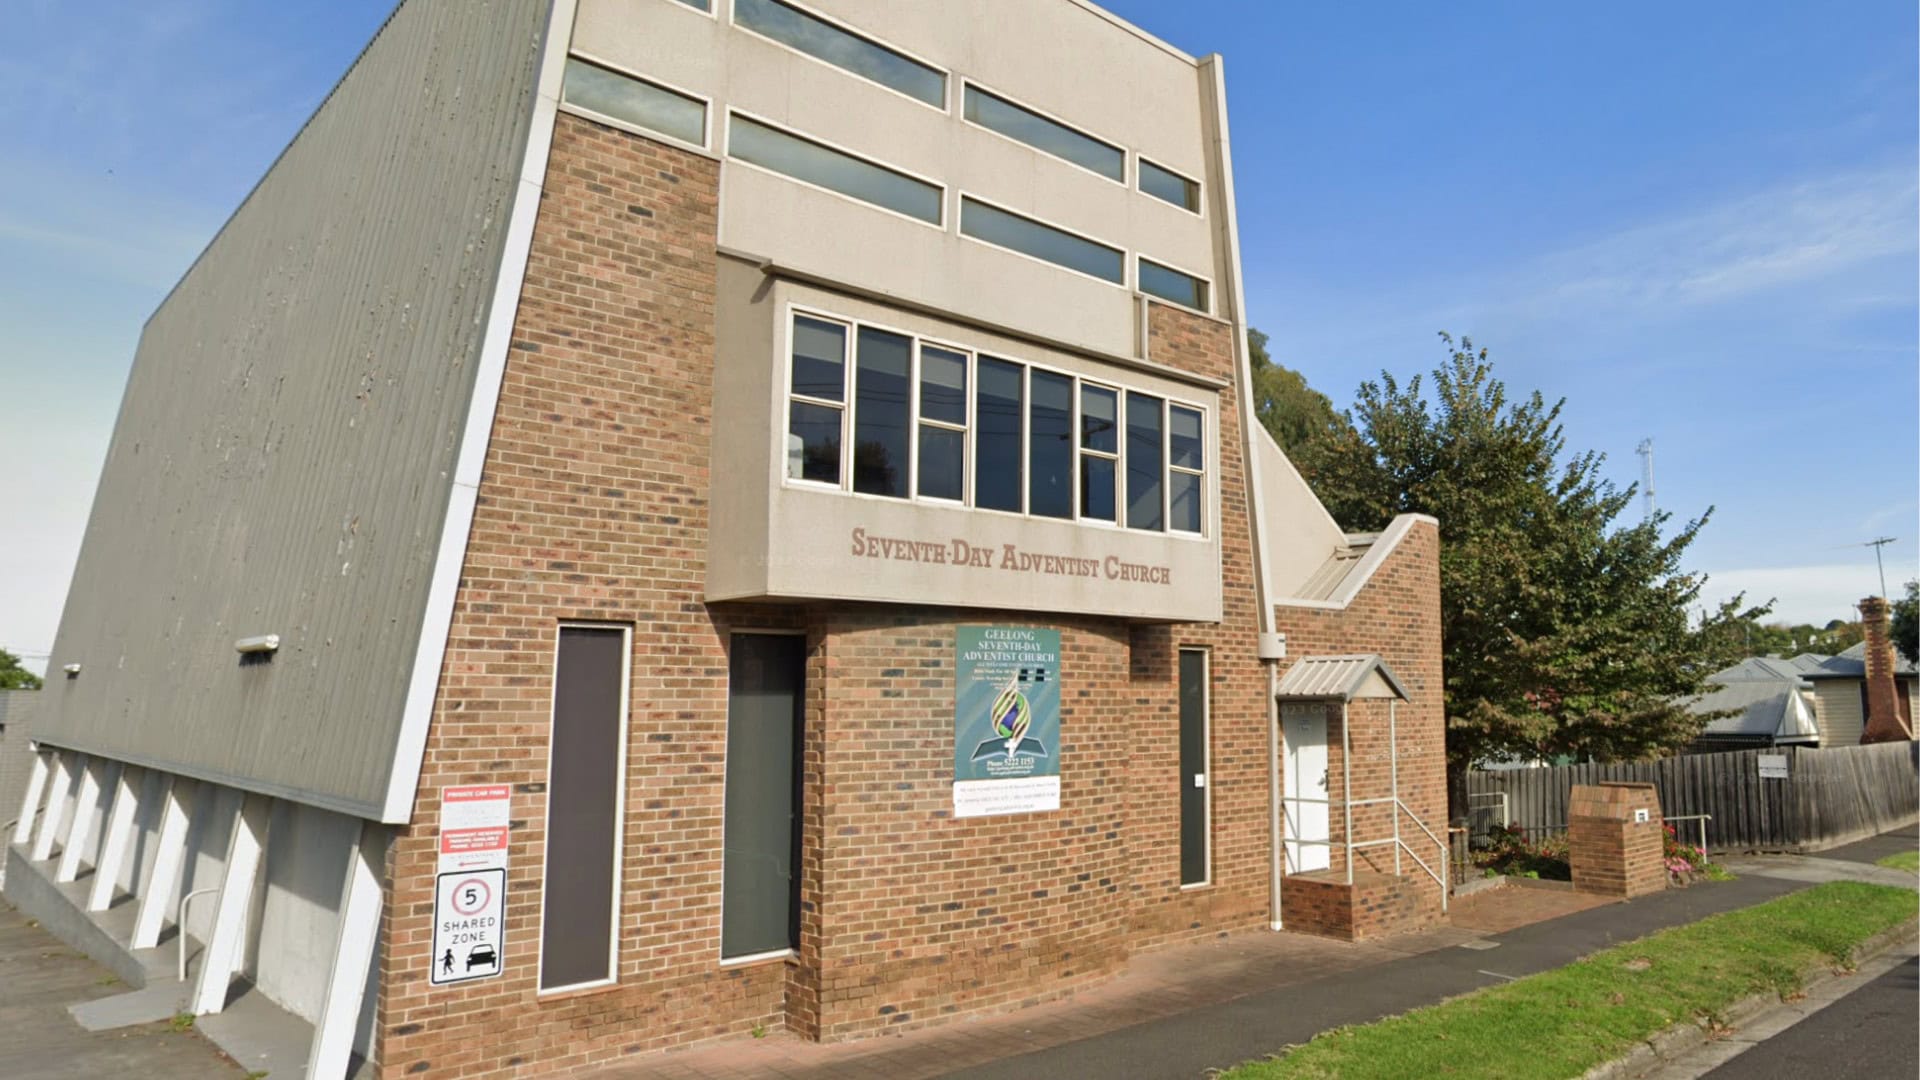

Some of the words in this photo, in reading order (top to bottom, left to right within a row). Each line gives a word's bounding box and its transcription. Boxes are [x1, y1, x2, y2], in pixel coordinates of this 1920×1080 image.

[1000, 543, 1099, 577] ADVENTIST
[1104, 555, 1171, 585] CHURCH
[985, 629, 1034, 641] GEELONG
[978, 641, 1042, 651] SEVENTH-DAY
[963, 651, 1018, 661] ADVENTIST
[1018, 653, 1055, 662] CHURCH
[465, 888, 477, 905] 5
[443, 916, 495, 932] SHARED
[452, 931, 486, 944] ZONE
